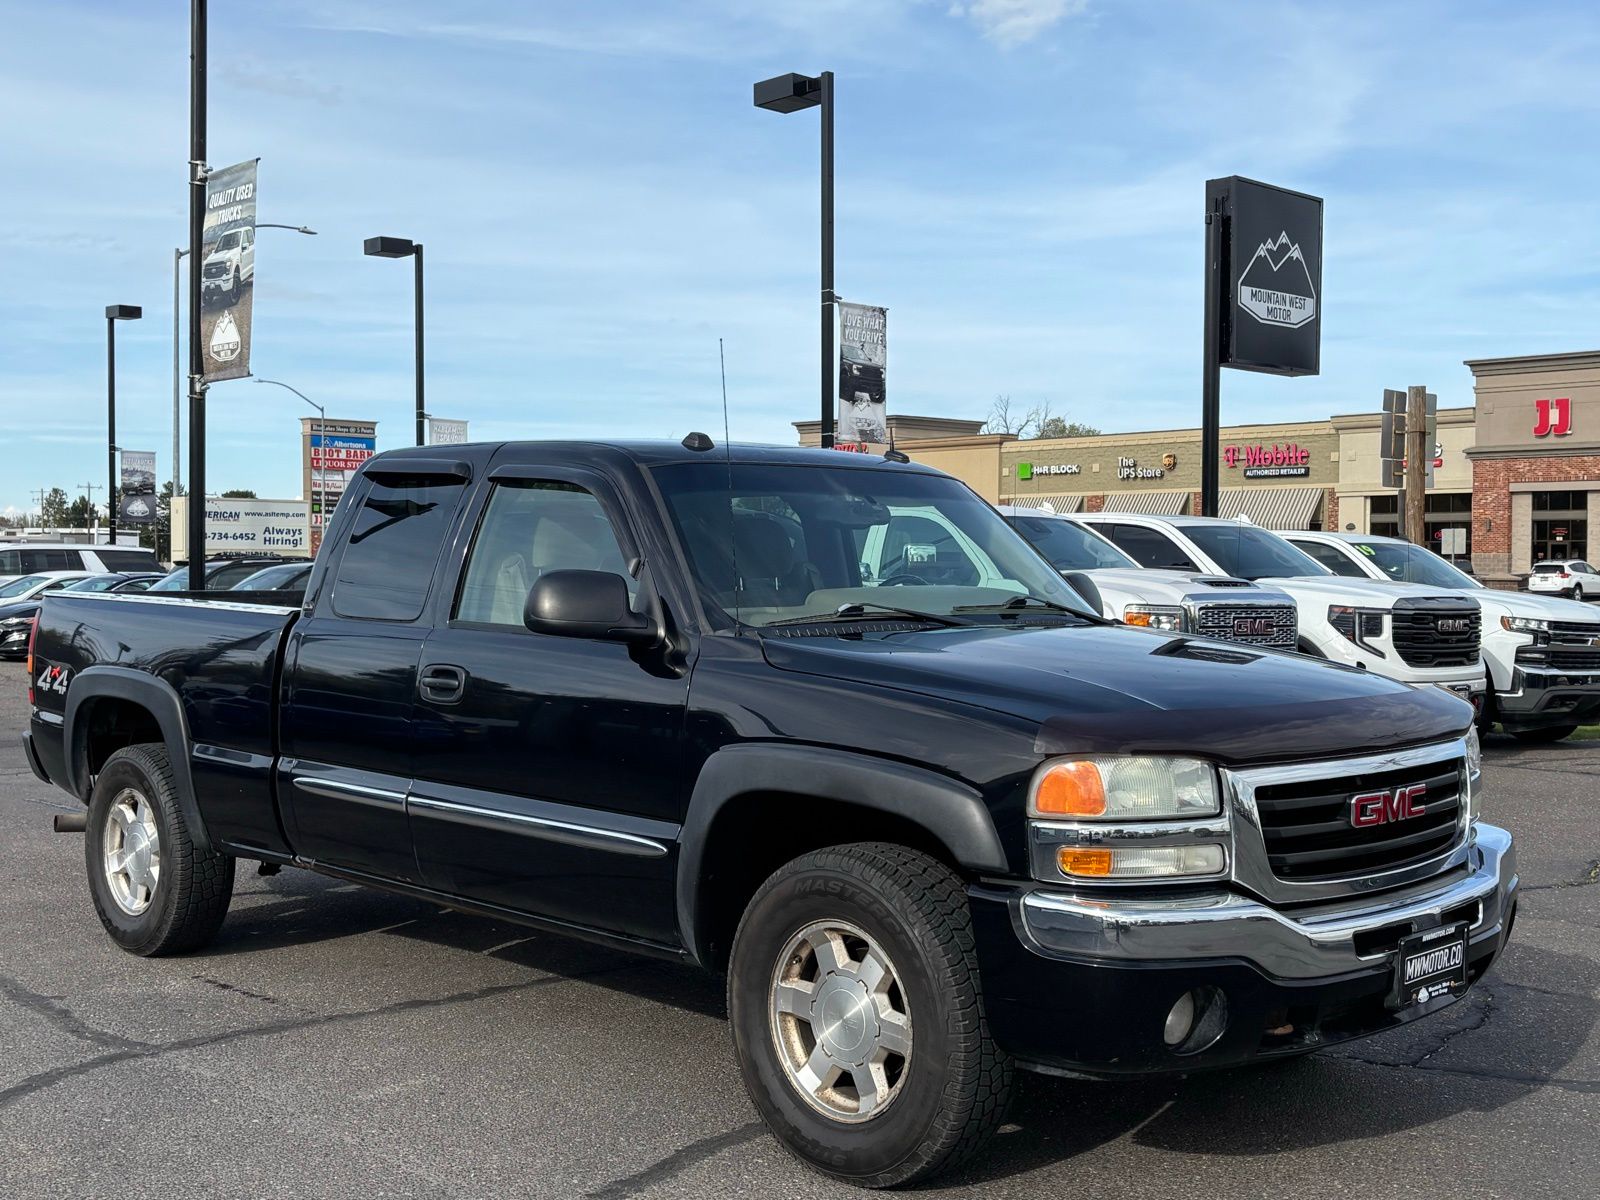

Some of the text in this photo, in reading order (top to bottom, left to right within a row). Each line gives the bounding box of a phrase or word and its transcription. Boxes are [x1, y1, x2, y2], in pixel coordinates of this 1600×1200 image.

[209, 183, 253, 209] QUALITY USED
[218, 205, 242, 224] TRUCKS
[1250, 288, 1307, 311] MOUNTAIN WEST
[844, 312, 884, 330] LOVE WHAT
[1266, 305, 1292, 321] MOTOR
[845, 327, 884, 344] YOU DRIVE
[334, 440, 366, 449] Albertsons
[313, 448, 373, 459] BOT BARN
[1117, 456, 1135, 467] The
[1223, 443, 1310, 468] T-Mobile
[1050, 465, 1080, 473] BLOCK
[1117, 467, 1161, 478] UPS Store
[1246, 468, 1305, 477] AUTHORIZED RETAILER
[262, 526, 303, 537] Always
[263, 536, 303, 548] Hiring!
[1234, 618, 1277, 635] GMC
[1438, 620, 1470, 632] GMC
[1350, 783, 1426, 828] GMC
[1406, 944, 1462, 981] MWMOTOR.CO
